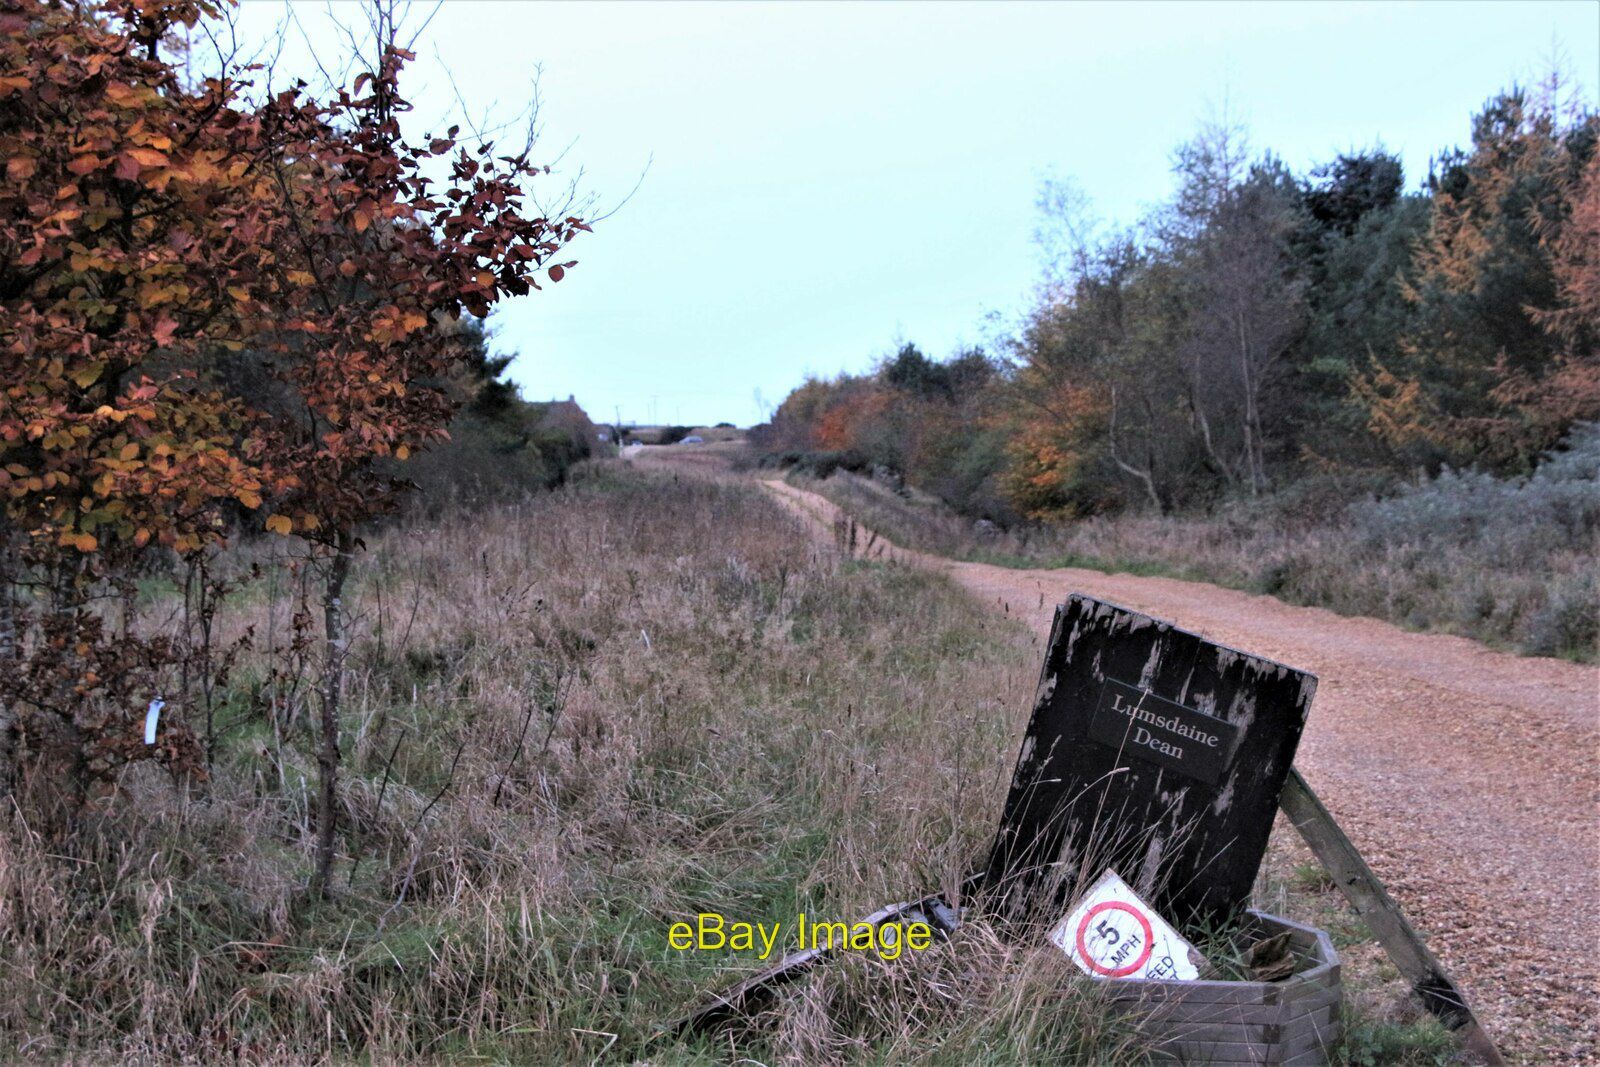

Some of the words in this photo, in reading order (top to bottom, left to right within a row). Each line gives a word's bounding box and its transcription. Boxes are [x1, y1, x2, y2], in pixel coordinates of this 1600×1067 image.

[1111, 694, 1219, 747] Lumsdaine
[1132, 726, 1184, 759] Dean
[1096, 920, 1120, 945] 5
[1110, 934, 1141, 965] MPH
